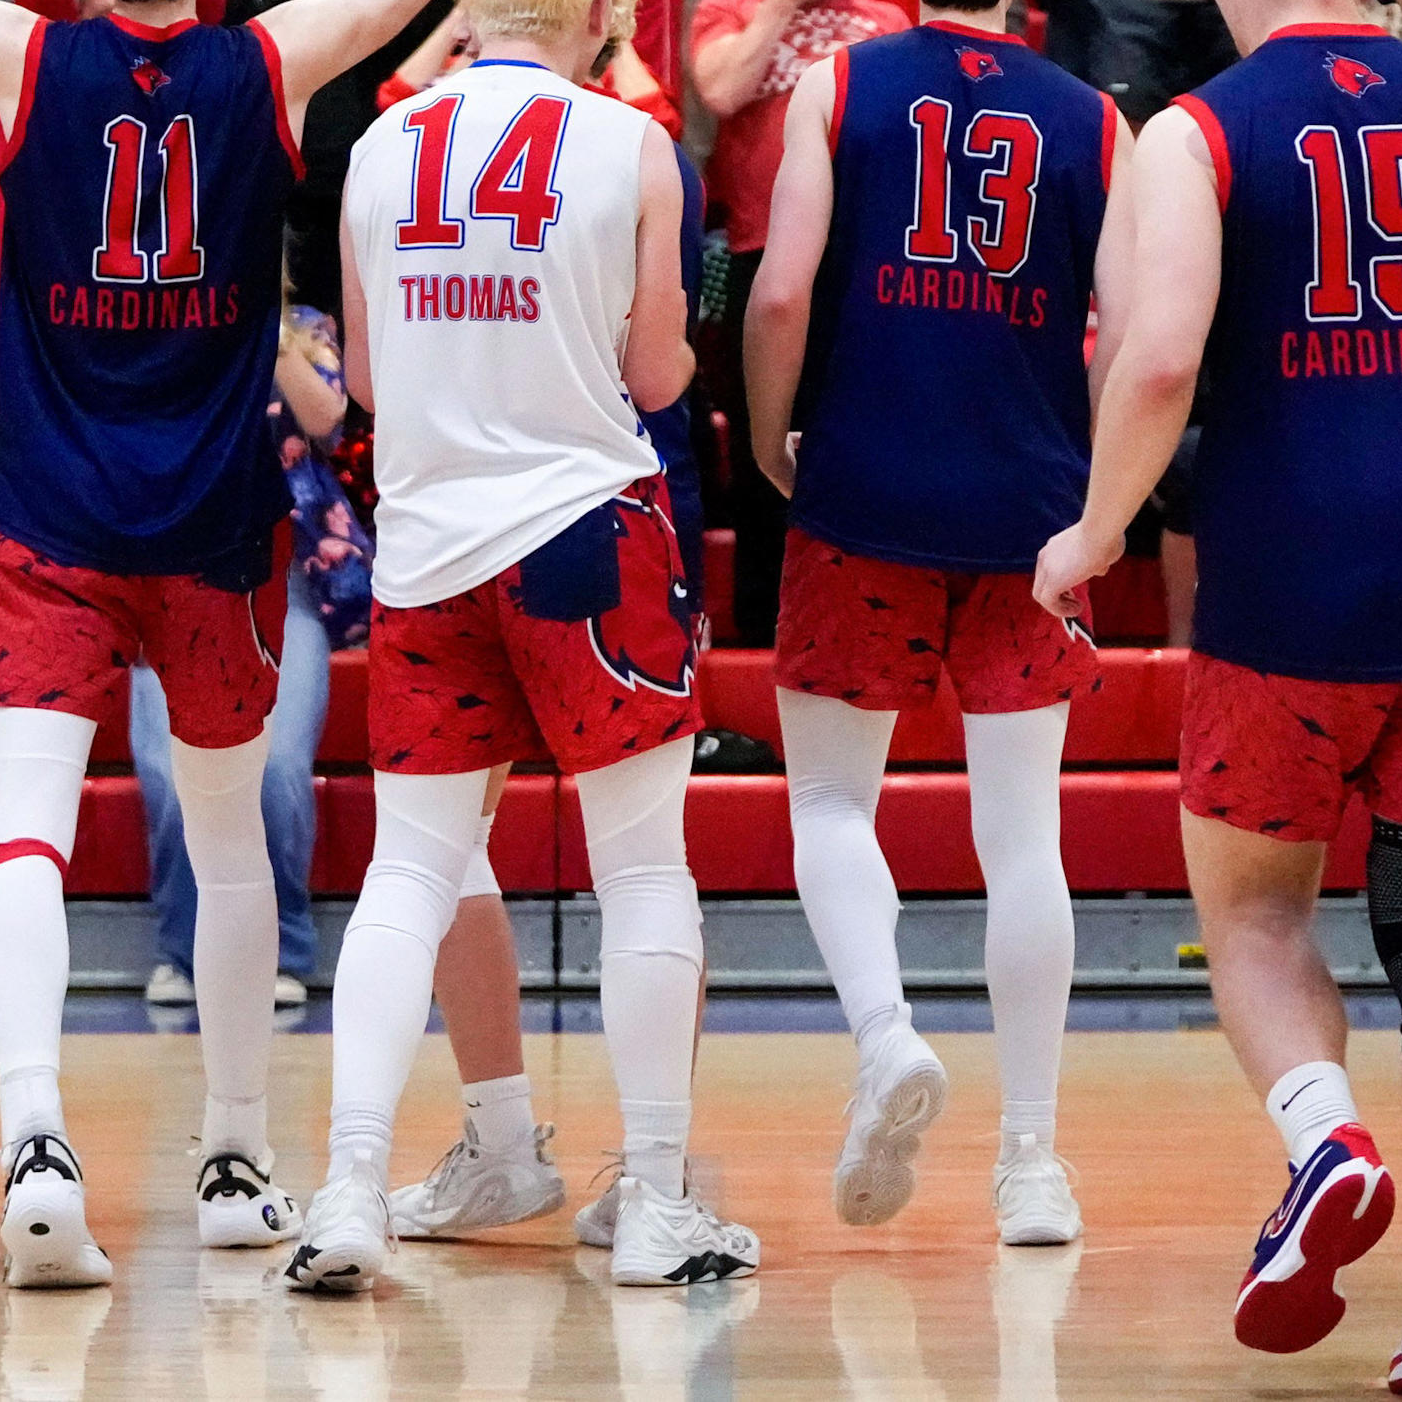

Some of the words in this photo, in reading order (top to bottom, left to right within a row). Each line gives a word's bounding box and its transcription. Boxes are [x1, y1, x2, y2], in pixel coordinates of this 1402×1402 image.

[92, 114, 205, 284] 11
[395, 93, 572, 253] 14
[905, 95, 1044, 278] 13
[47, 282, 240, 330] CARDINALS
[399, 274, 541, 323] THOMAS
[876, 264, 1049, 329] CARDINLS
